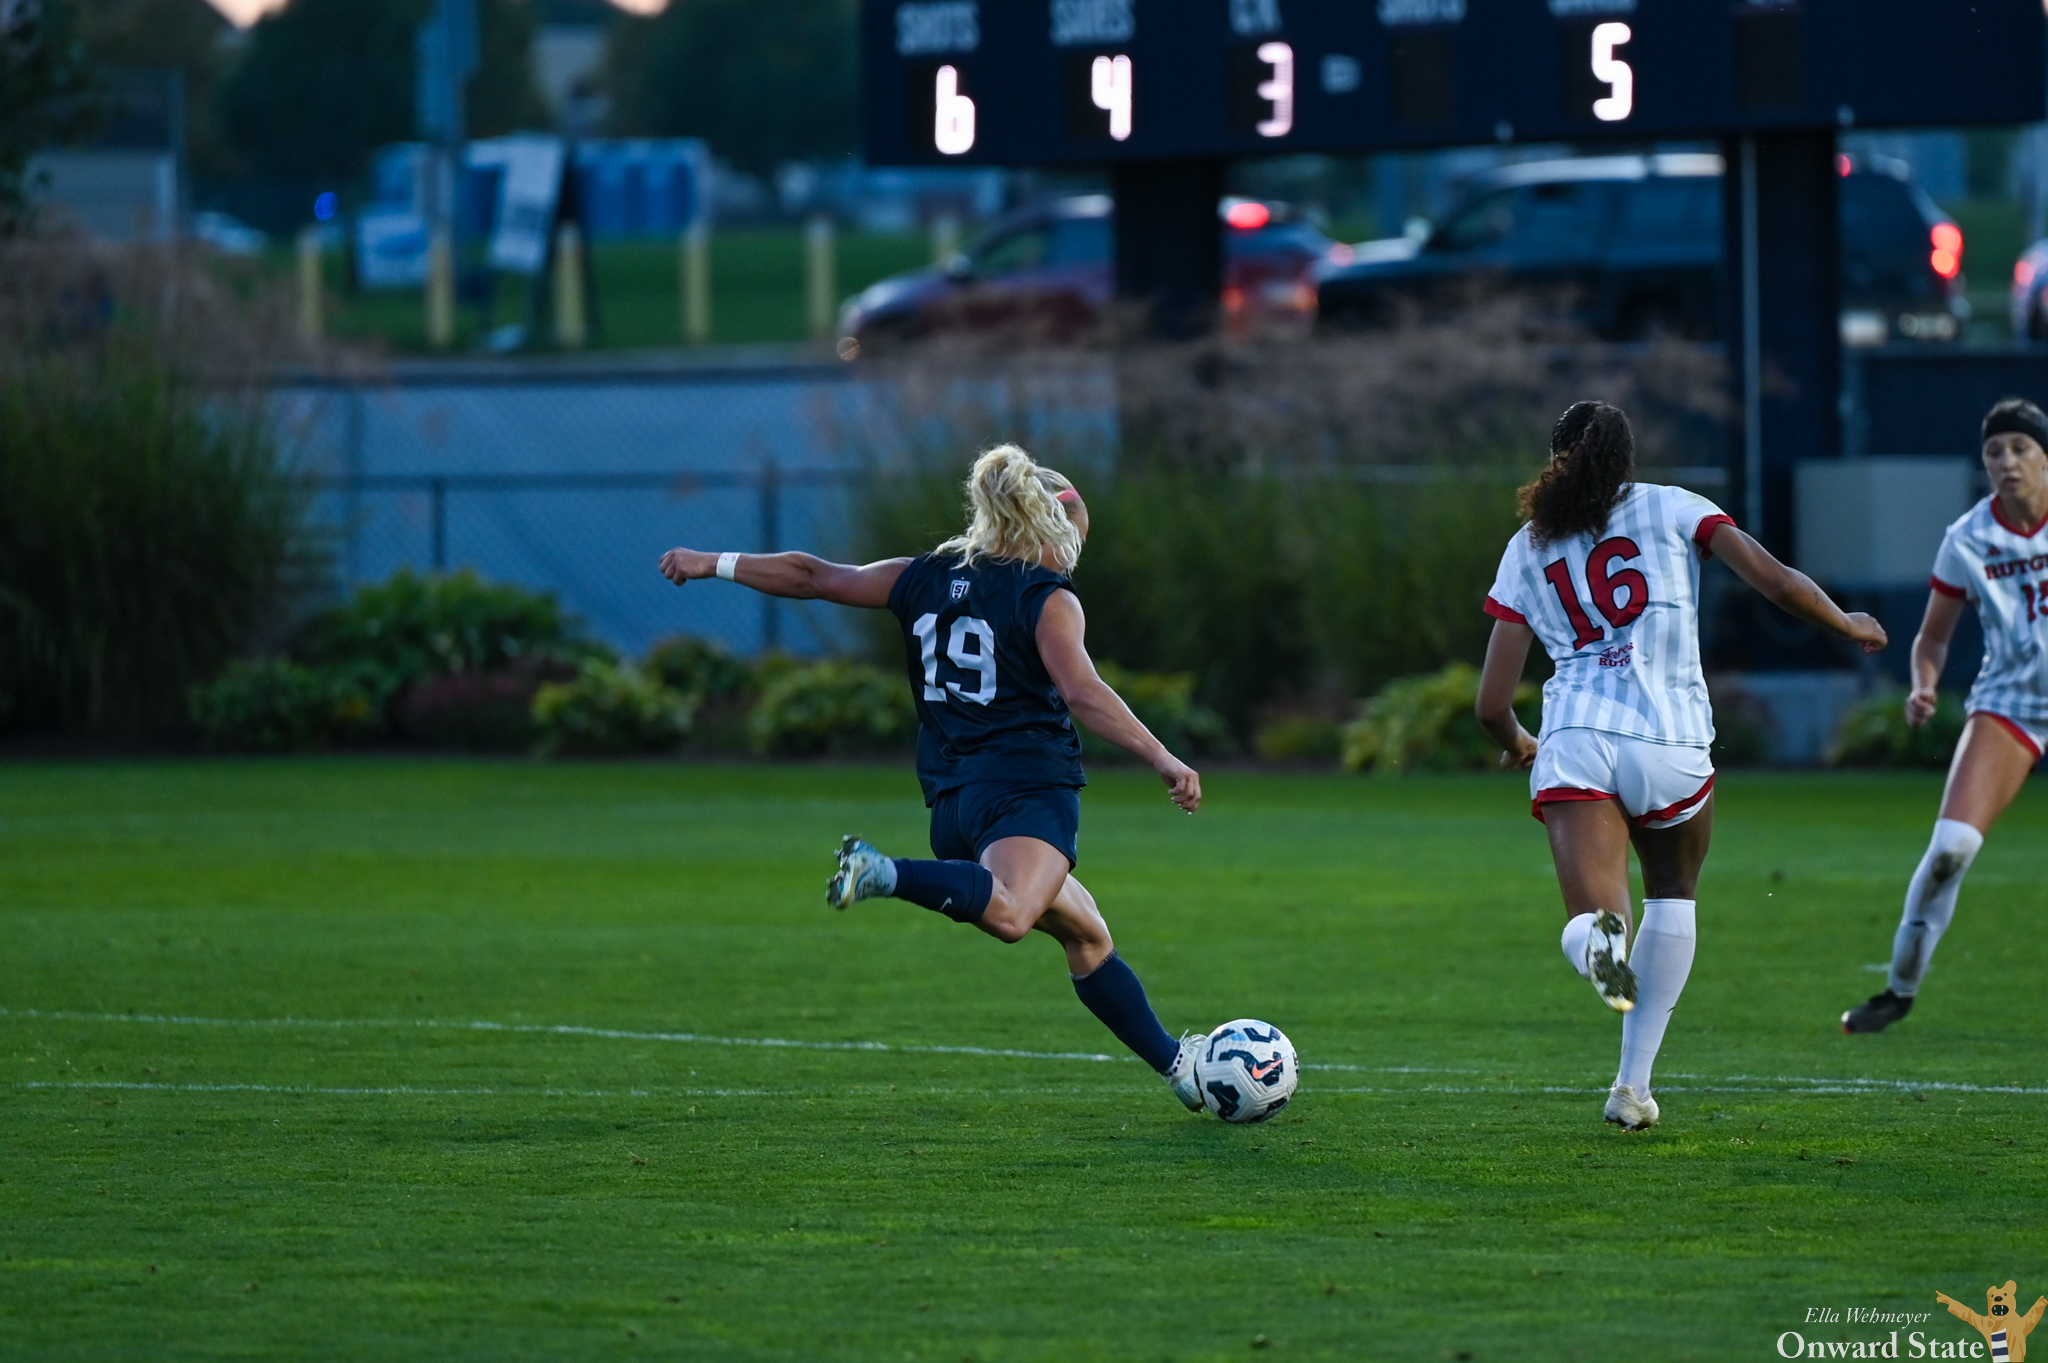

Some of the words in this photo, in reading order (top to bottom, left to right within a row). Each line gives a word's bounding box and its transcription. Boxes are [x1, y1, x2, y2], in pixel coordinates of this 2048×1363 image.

[935, 65, 975, 154] 6
[1092, 55, 1132, 140] 4
[1257, 42, 1293, 137] 3
[1591, 22, 1632, 121] 5
[1543, 536, 1649, 651] 16
[1984, 554, 2048, 580] RUTG
[912, 612, 997, 706] 19
